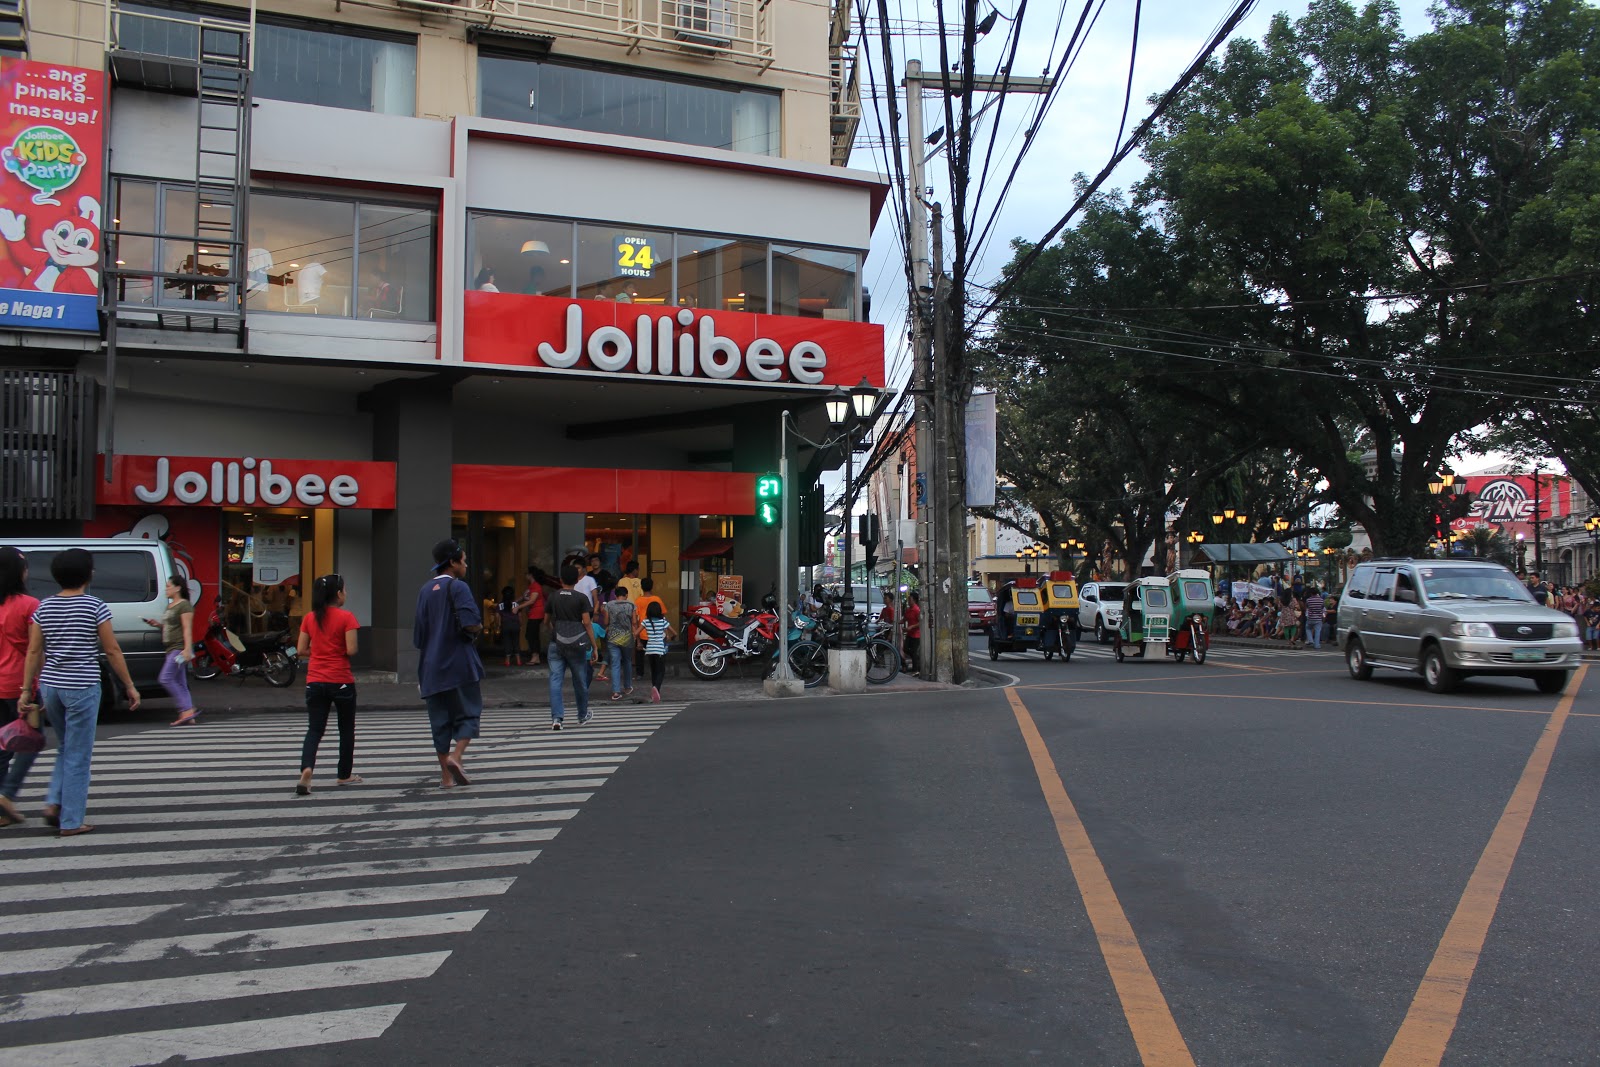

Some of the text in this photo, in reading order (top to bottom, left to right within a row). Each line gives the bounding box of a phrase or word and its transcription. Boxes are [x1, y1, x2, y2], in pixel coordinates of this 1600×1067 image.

[15, 82, 95, 103] pinaka-
[9, 102, 98, 126] masaya!
[24, 131, 64, 141] Jollibee
[22, 162, 76, 179] party
[624, 237, 647, 245] OPEN
[618, 243, 654, 269] 24
[621, 268, 651, 277] HOURS
[11, 301, 53, 319] Naga
[56, 305, 65, 319] 1
[537, 303, 827, 384] Jollibee
[134, 456, 359, 506] Jollibee
[759, 479, 779, 496] 27
[1468, 498, 1542, 518] STING
